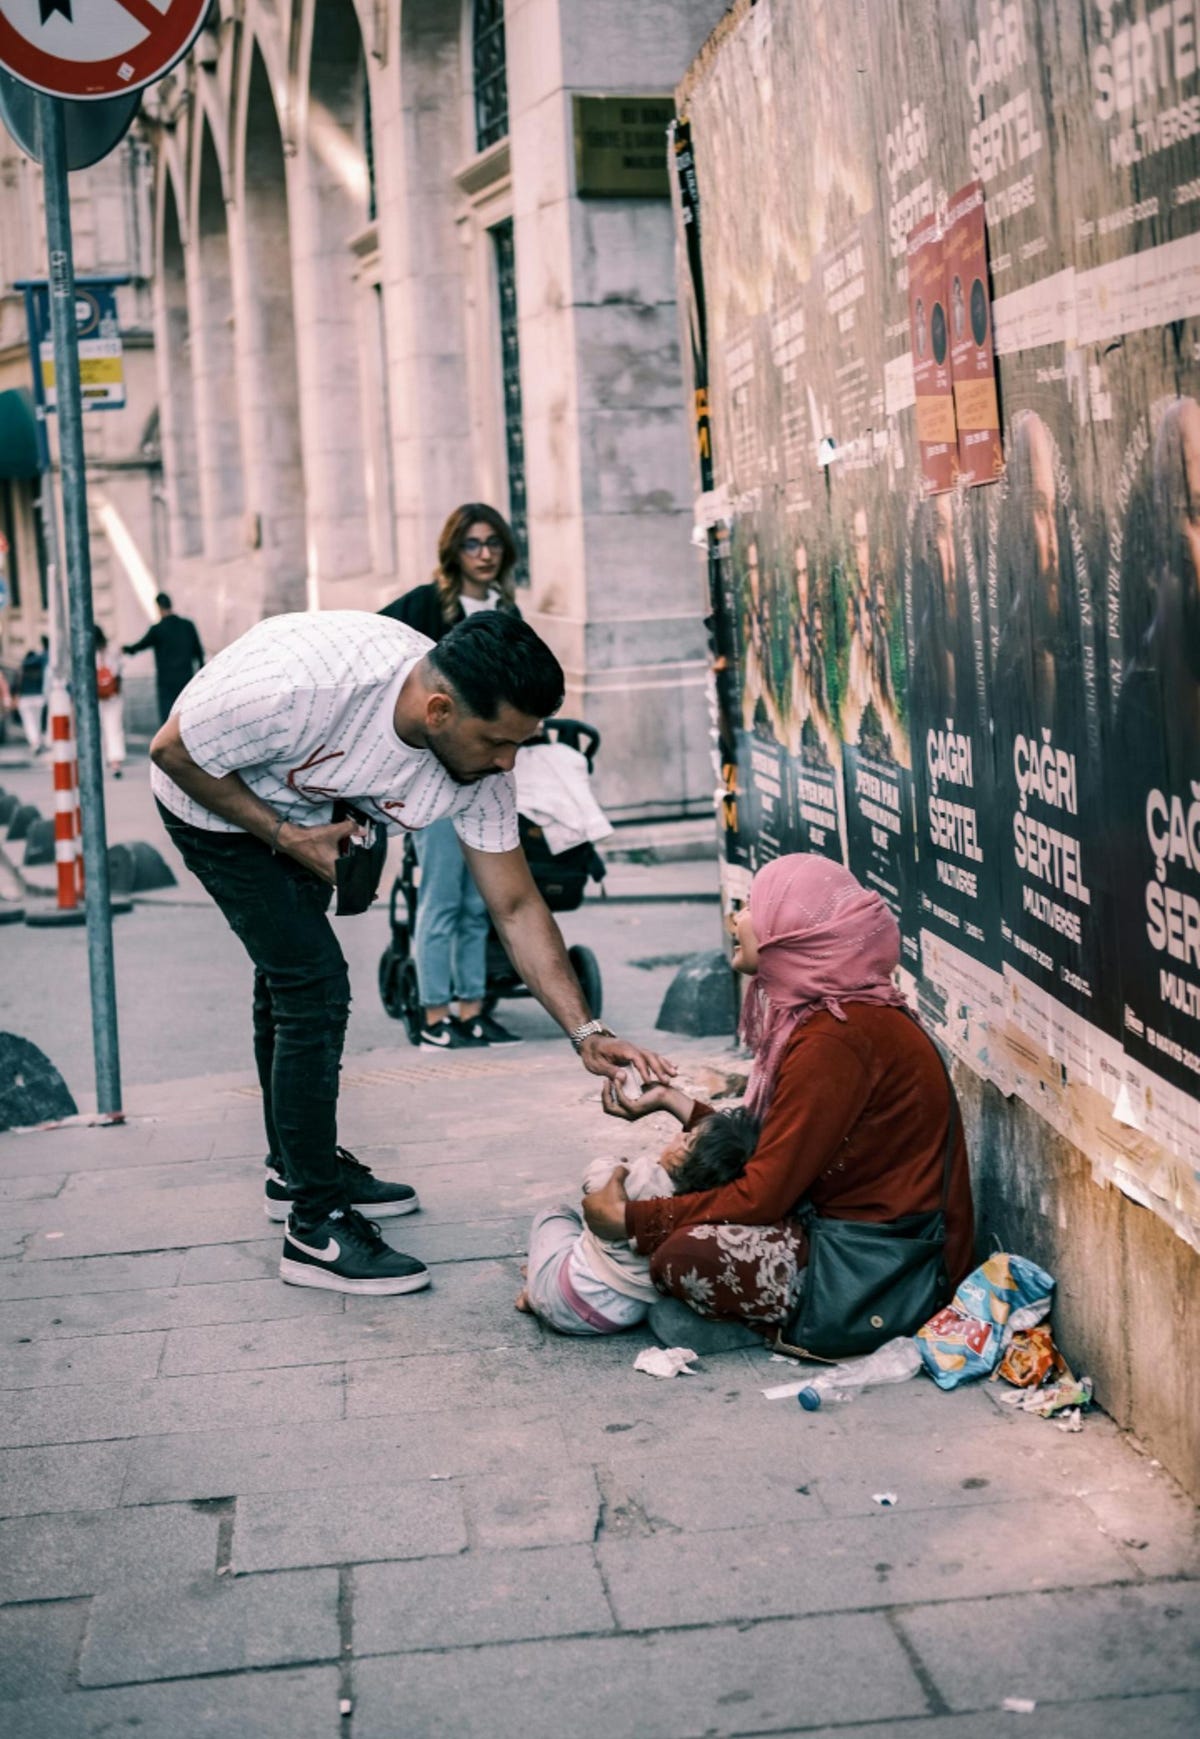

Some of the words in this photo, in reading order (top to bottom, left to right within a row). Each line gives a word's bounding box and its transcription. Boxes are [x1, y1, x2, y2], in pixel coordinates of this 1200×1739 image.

[1092, 0, 1200, 120] SERTE
[969, 89, 1042, 182] SERTEL
[927, 718, 974, 794] ÇAĞRI
[1013, 727, 1078, 816] ÇAĞRI
[928, 795, 984, 863] SERTEL
[1013, 811, 1091, 905] SERTEL
[1022, 885, 1082, 944] MULTIVERSE
